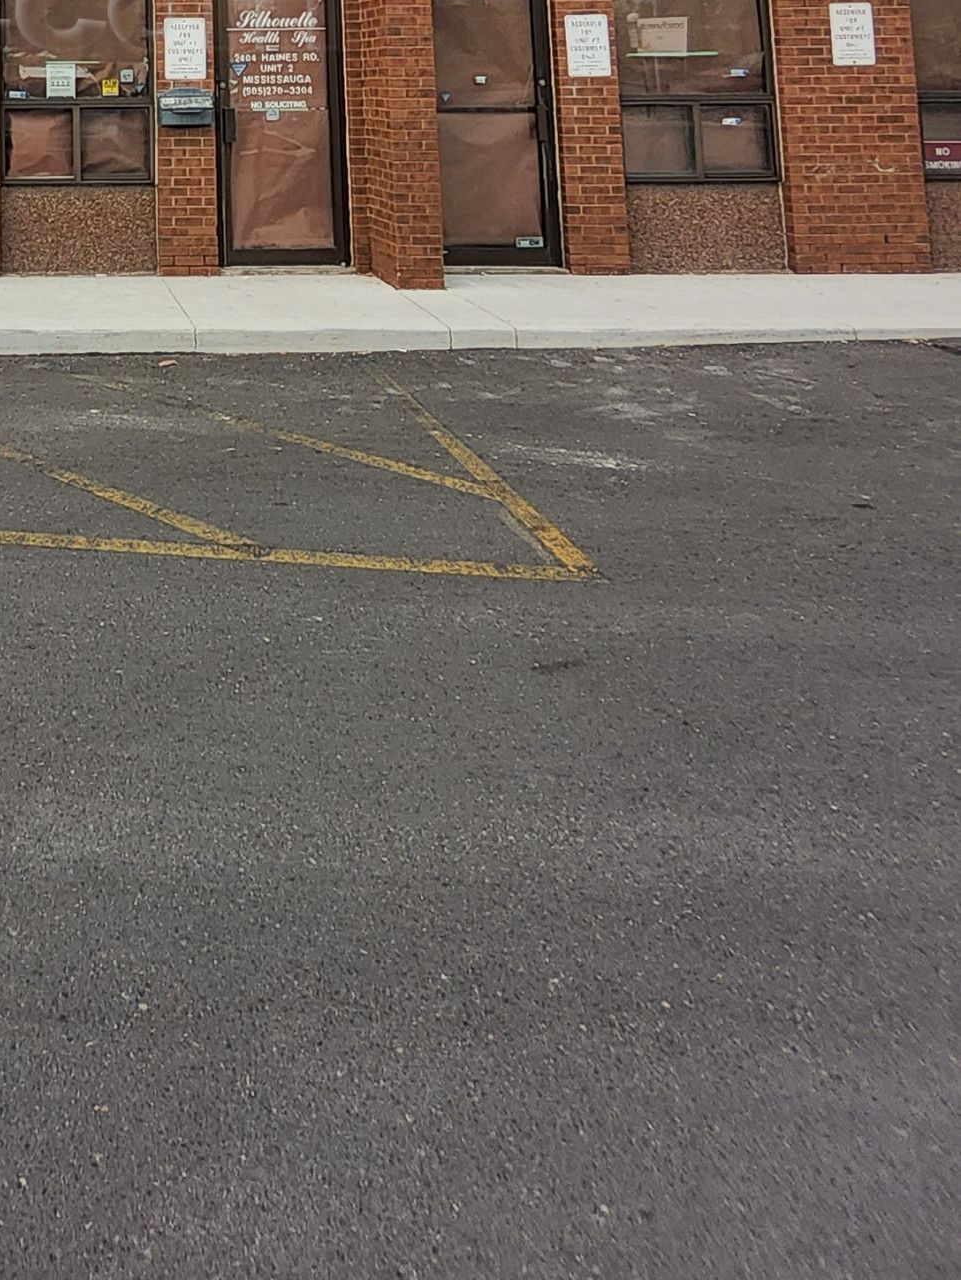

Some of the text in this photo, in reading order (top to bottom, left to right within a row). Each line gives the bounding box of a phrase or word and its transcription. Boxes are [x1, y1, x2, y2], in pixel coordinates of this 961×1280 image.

[236, 10, 318, 27] Silhouette
[239, 31, 317, 47] Health Spa
[234, 53, 320, 62] 2404 HAINES RD.
[260, 64, 294, 72] UNIT 2
[242, 75, 312, 84] MISSISSAUGA
[242, 86, 313, 97] (905)270-3304
[935, 147, 950, 156] NO
